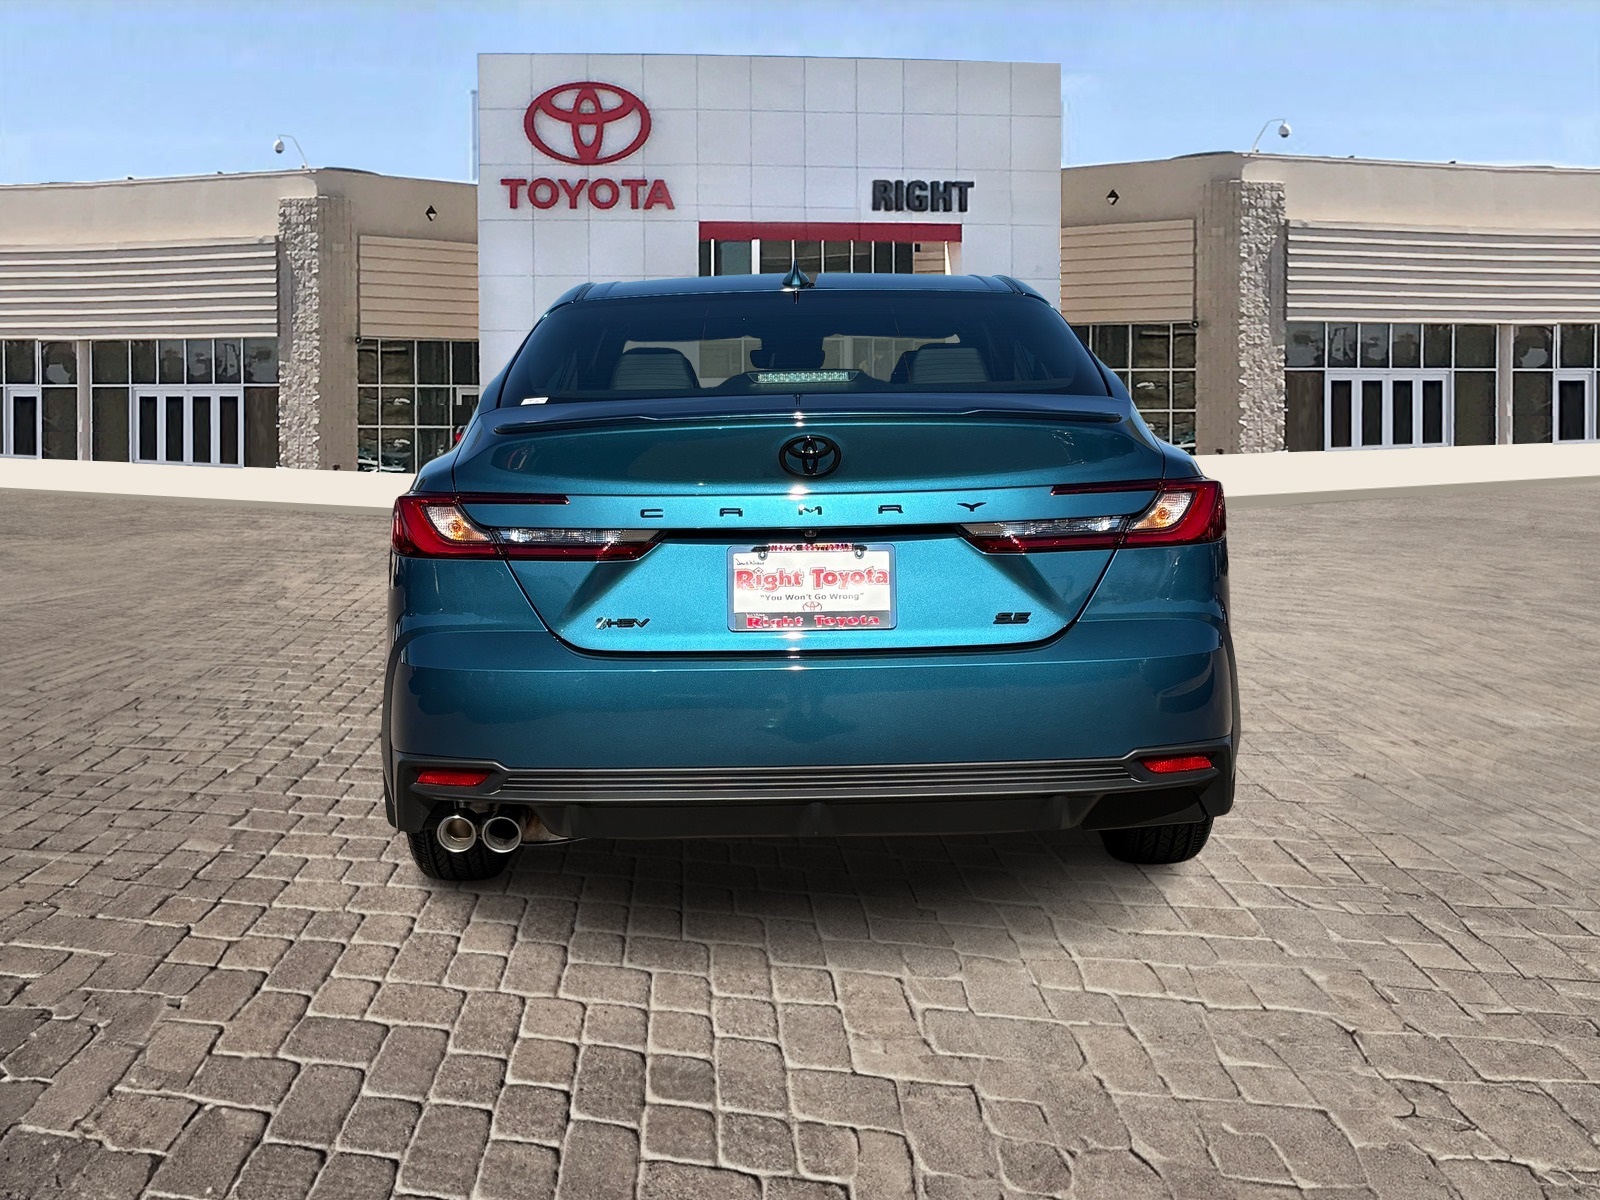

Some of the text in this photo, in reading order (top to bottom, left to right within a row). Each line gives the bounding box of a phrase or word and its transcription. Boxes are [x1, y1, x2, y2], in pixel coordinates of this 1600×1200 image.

[501, 177, 675, 210] TOYOTA
[872, 179, 974, 212] RIGHT
[640, 502, 987, 518] CAMRY
[735, 566, 889, 592] Right Toyota
[785, 593, 812, 601] Won't
[746, 614, 880, 629] Right Toyota
[993, 612, 1031, 625] SE
